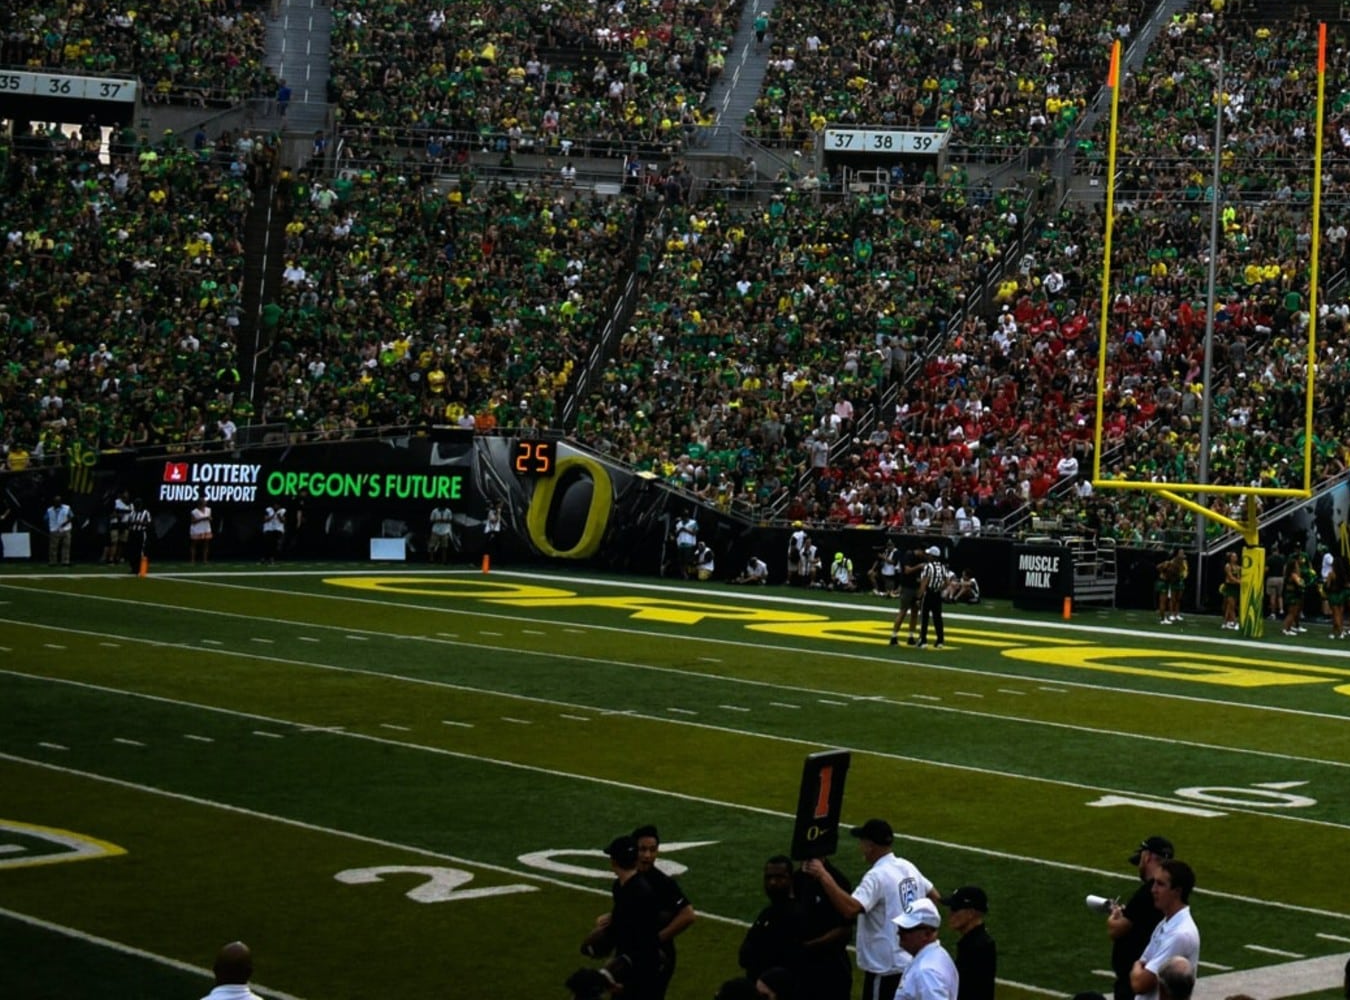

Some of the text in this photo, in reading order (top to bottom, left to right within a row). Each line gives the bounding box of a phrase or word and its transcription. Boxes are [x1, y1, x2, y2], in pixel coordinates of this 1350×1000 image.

[0, 76, 121, 98] 35 36 37
[835, 134, 932, 150] 37 38 39
[516, 443, 549, 472] 25
[192, 463, 261, 483] LOTTERY
[160, 484, 257, 502] FUNDS SUPPORT
[267, 471, 462, 498] OREGON'S FUTURE
[527, 456, 612, 558] O
[1019, 554, 1060, 572] MUSCLE
[1025, 572, 1051, 588] MILK
[814, 765, 832, 819] 1
